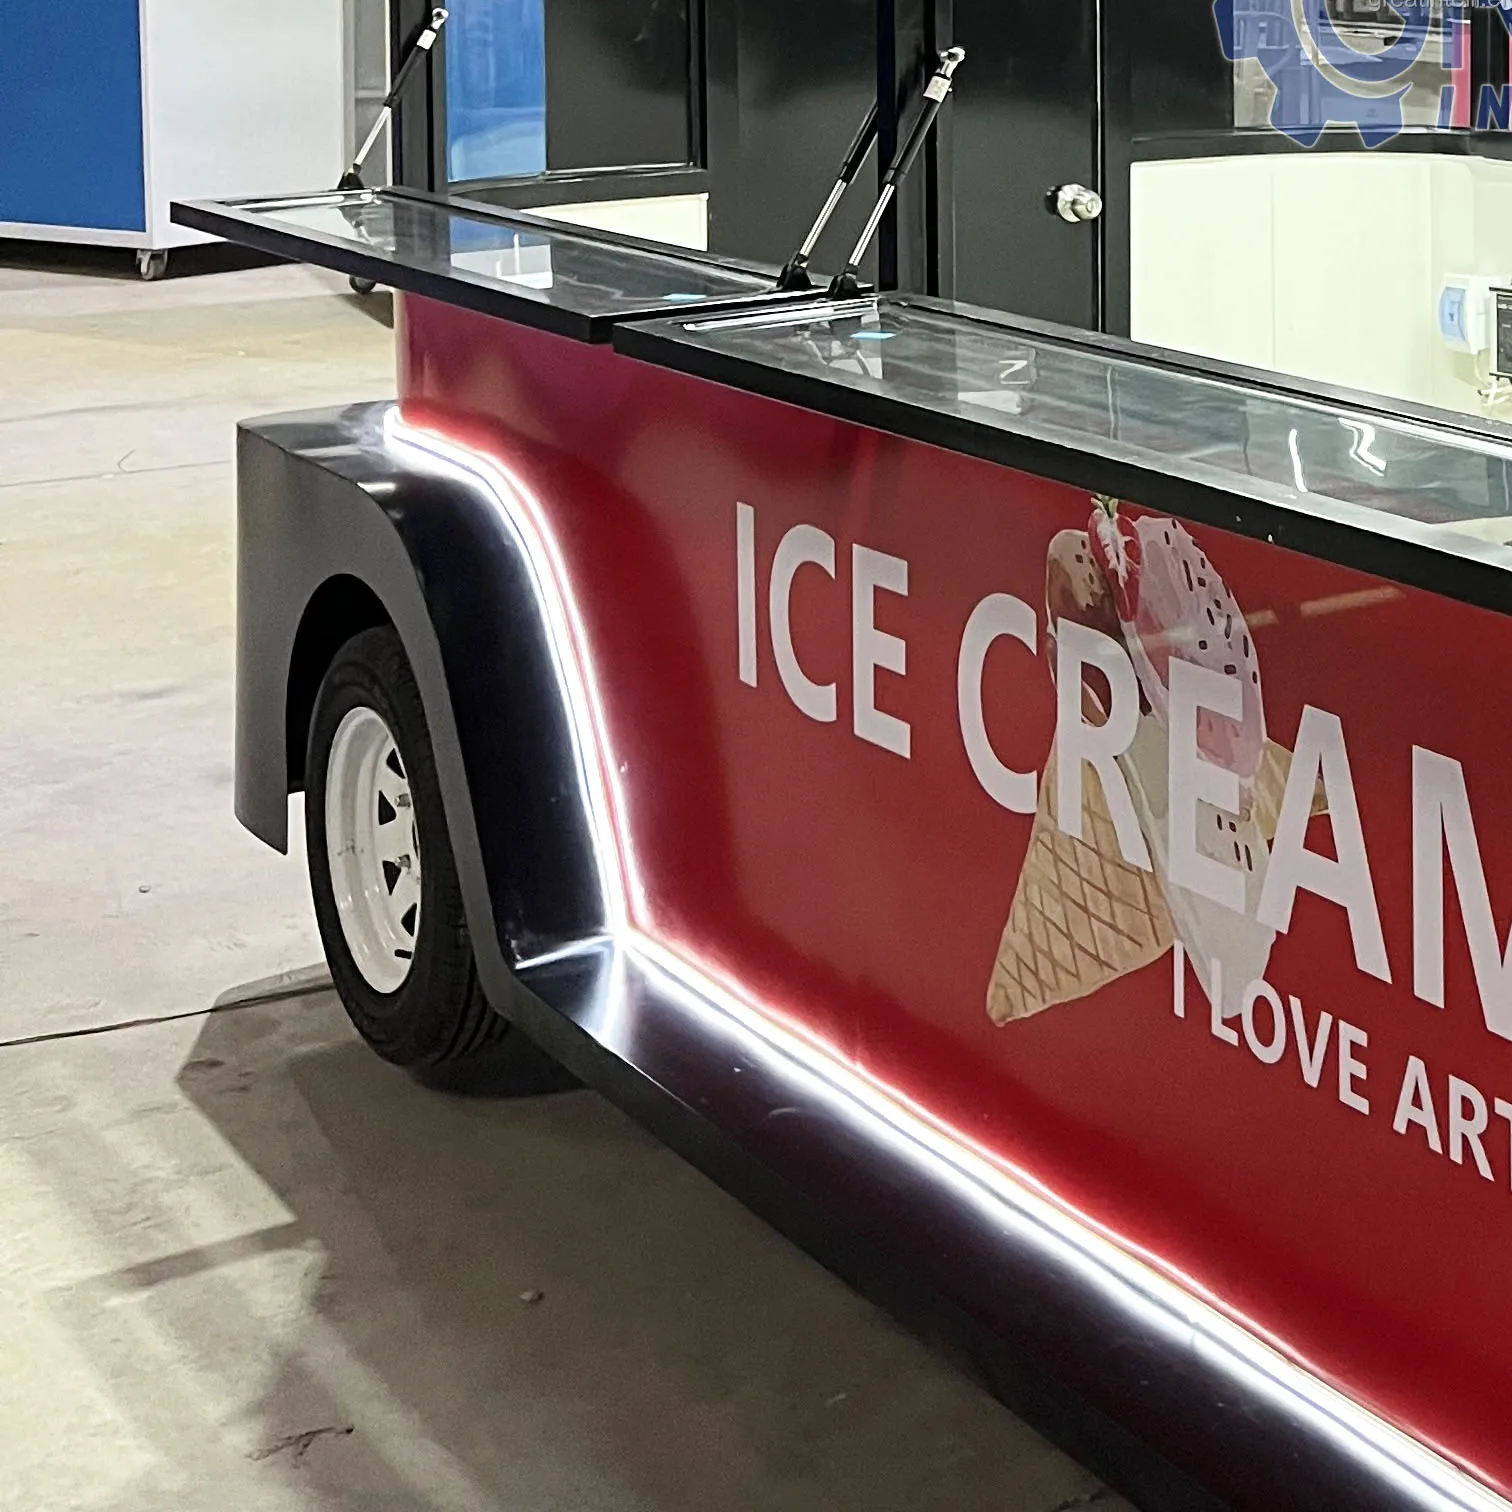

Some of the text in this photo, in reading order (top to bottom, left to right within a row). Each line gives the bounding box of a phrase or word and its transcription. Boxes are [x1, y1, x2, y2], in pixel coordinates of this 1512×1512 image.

[736, 500, 912, 759] ICE
[1173, 938, 1186, 1019] I
[1210, 956, 1371, 1116] LOVE
